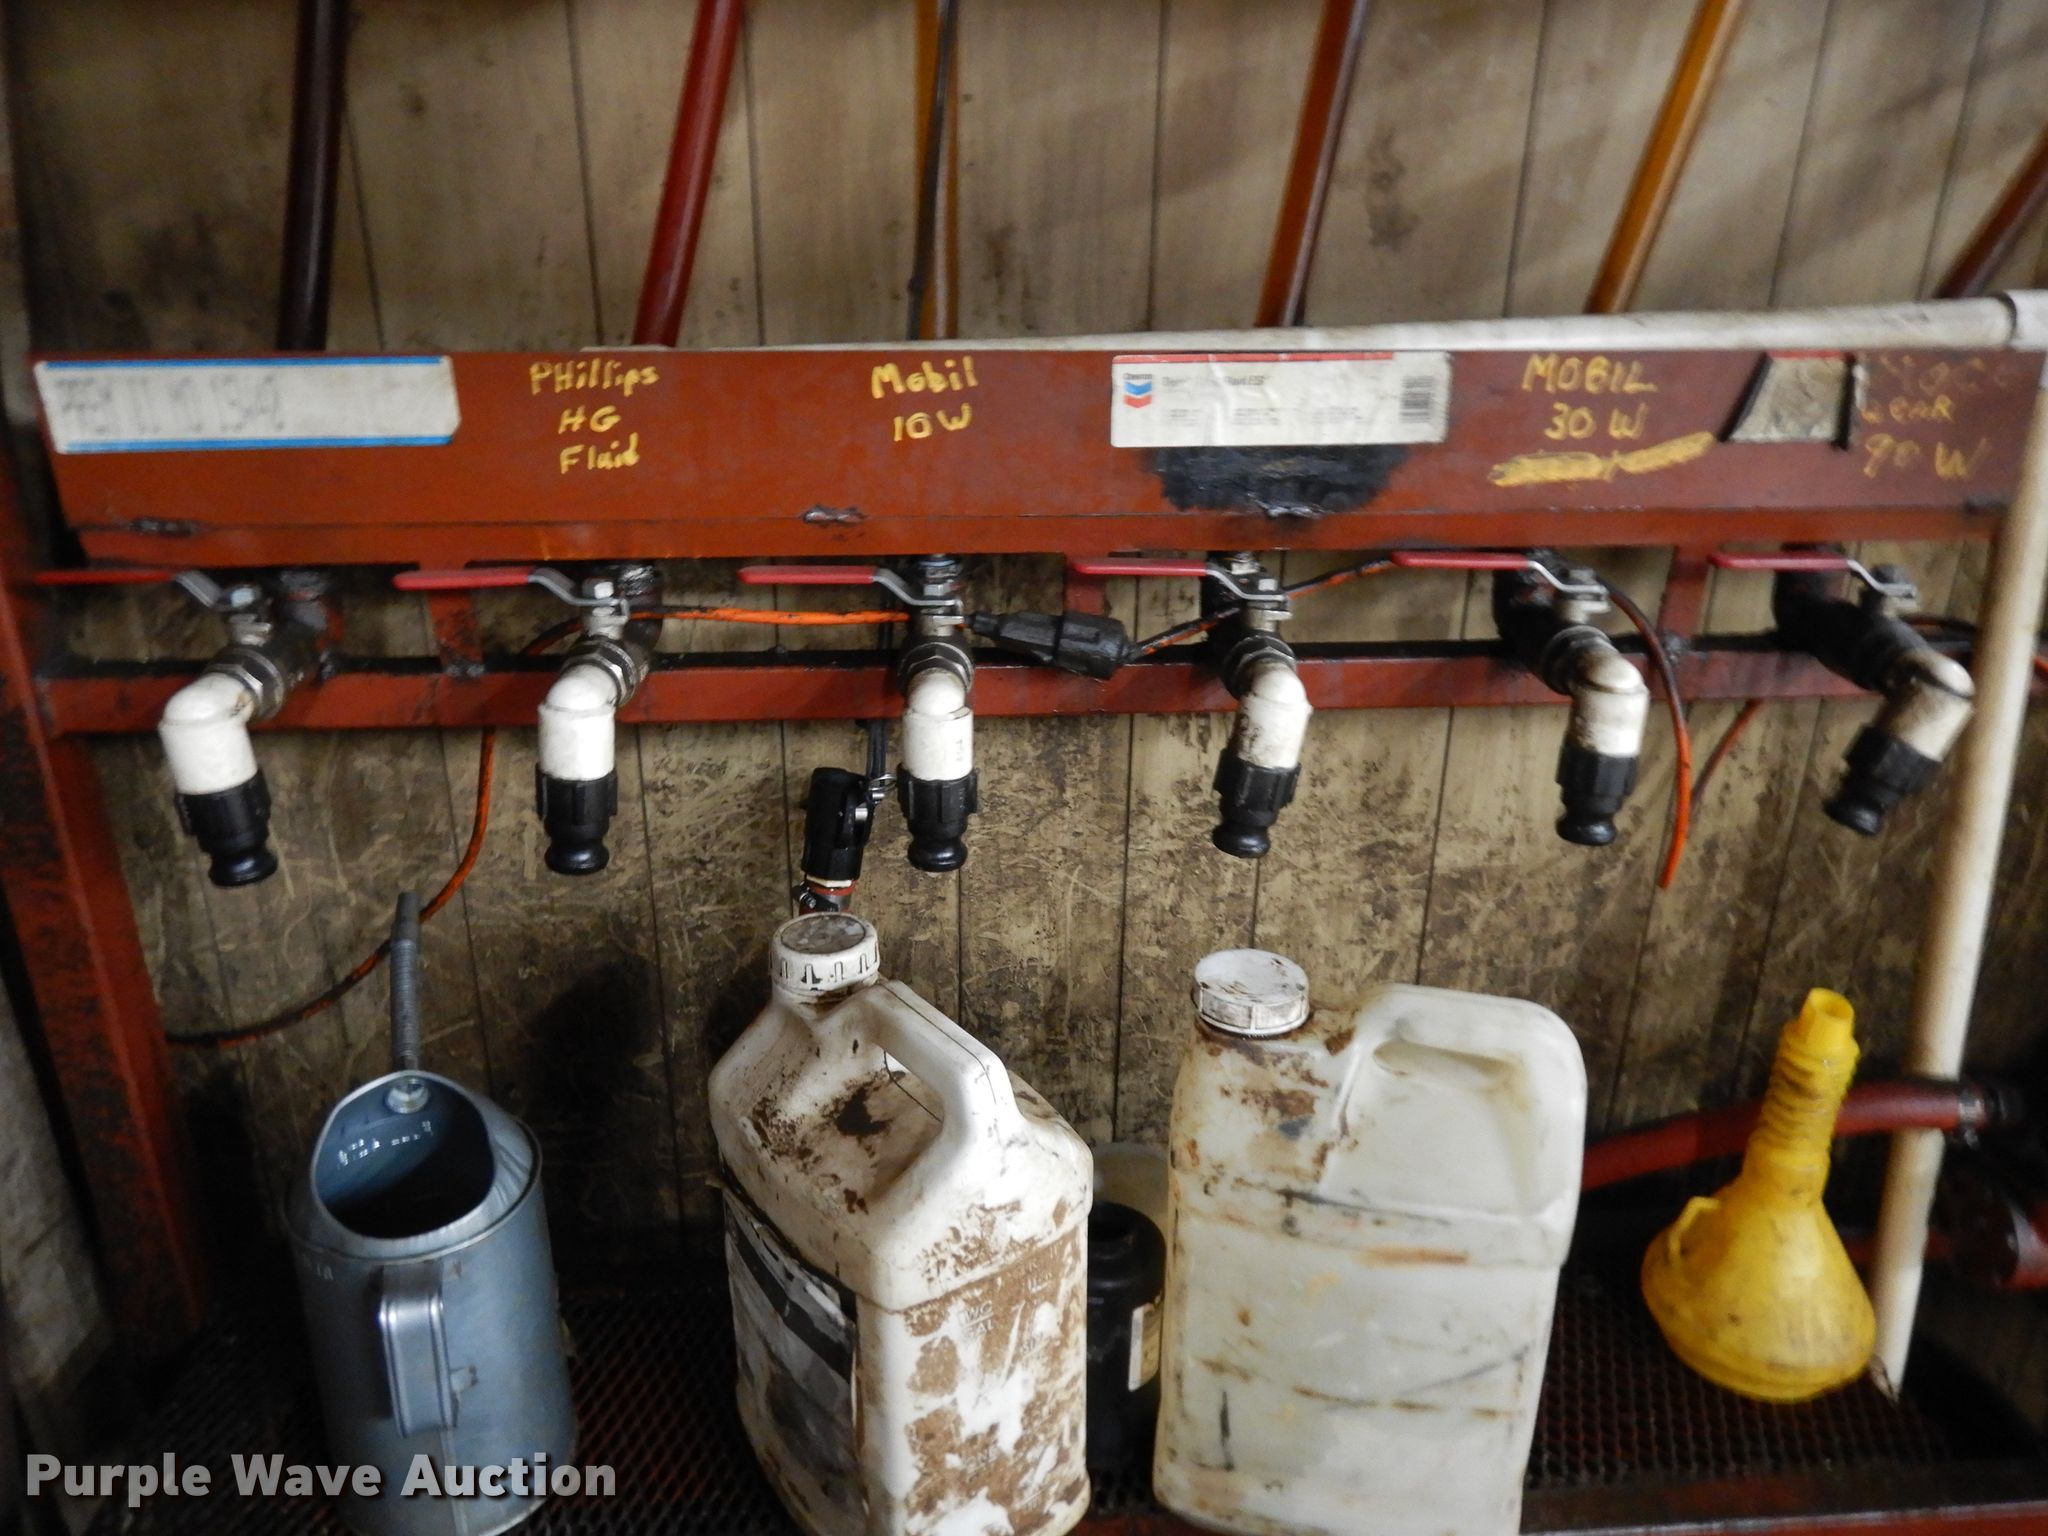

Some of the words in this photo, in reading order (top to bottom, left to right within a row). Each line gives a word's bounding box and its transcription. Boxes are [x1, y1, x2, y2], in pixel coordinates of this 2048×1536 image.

[871, 355, 979, 399] Mobil
[1521, 353, 1659, 394] MOBIL
[893, 411, 933, 442] 10
[1544, 402, 1597, 440] 30
[1608, 402, 1648, 440] W
